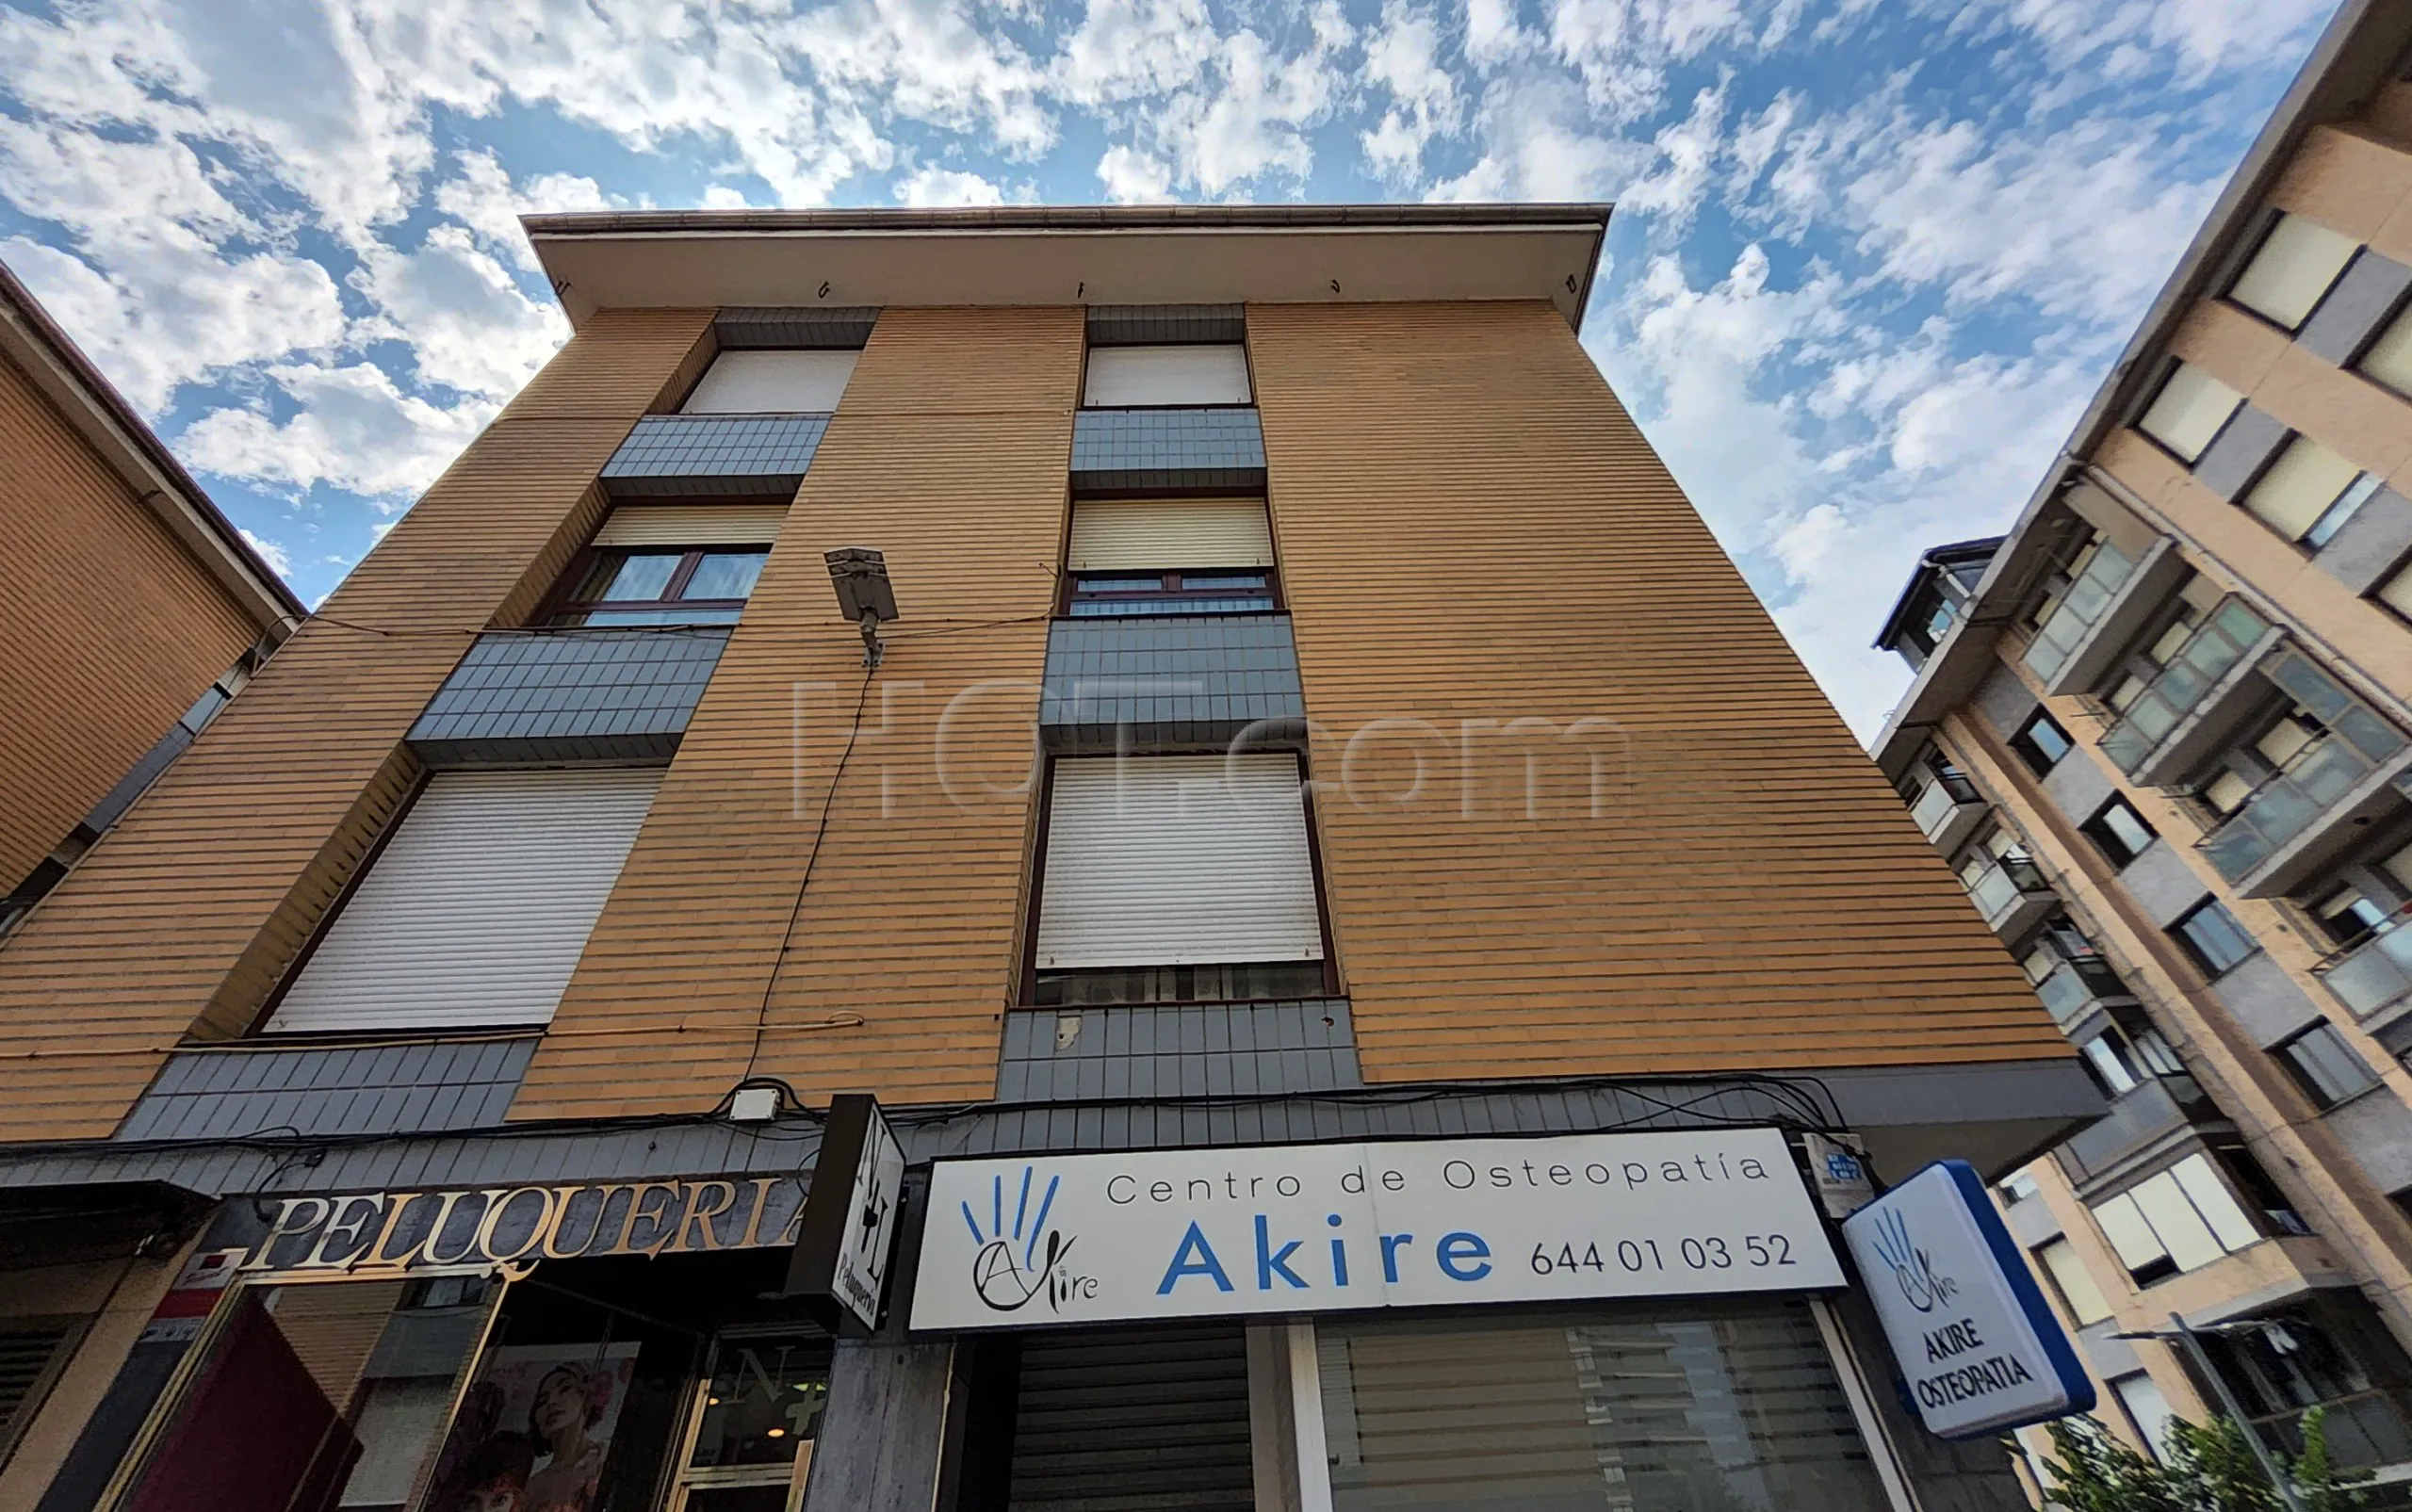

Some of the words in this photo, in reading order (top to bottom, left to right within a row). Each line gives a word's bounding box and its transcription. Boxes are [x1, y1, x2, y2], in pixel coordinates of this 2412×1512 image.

[1107, 1172, 1300, 1204] Centro
[1341, 1164, 1405, 1194] de
[1442, 1152, 1768, 1191] Osteopatía
[237, 1178, 807, 1281] PELUQUERI
[1155, 1214, 1492, 1294] Akire
[1531, 1242, 1605, 1275] 644
[1619, 1239, 1664, 1272] 01
[1681, 1237, 1733, 1270] 03
[1745, 1234, 1797, 1267] 52
[1922, 1318, 1984, 1363] AKIRE
[1916, 1354, 2034, 1408] OSTEOPATIA
